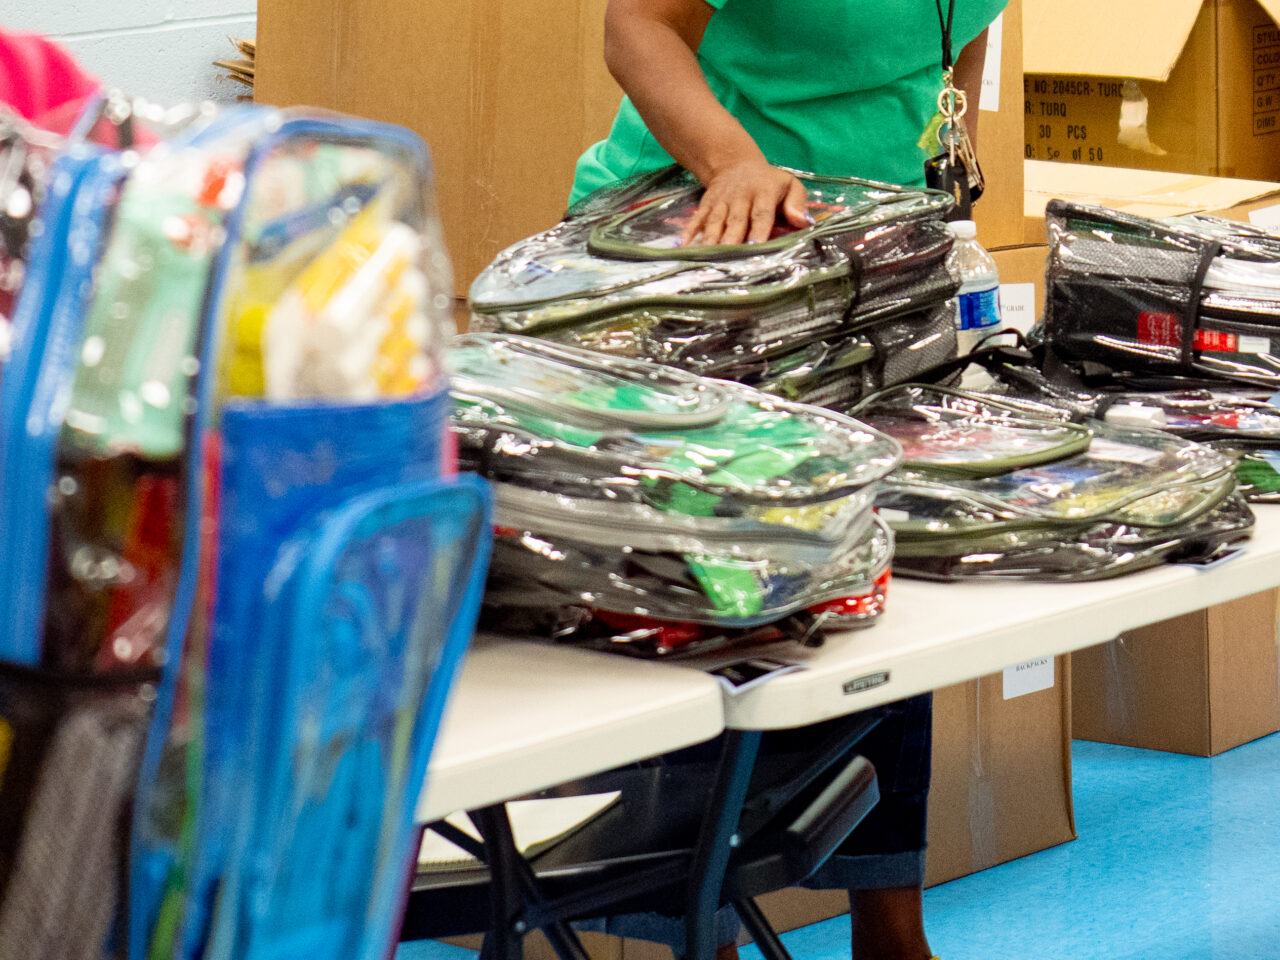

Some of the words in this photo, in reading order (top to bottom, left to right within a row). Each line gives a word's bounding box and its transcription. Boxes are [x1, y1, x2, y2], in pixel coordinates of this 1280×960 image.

[1040, 102, 1067, 117] TURQ
[1256, 116, 1276, 129] DIMS
[1039, 124, 1051, 139] 30
[1067, 125, 1087, 140] PCS
[1072, 146, 1081, 160] of
[1089, 147, 1103, 161] 50
[1006, 304, 1024, 312] GRADE
[1015, 659, 1048, 671] BACKPACKS
